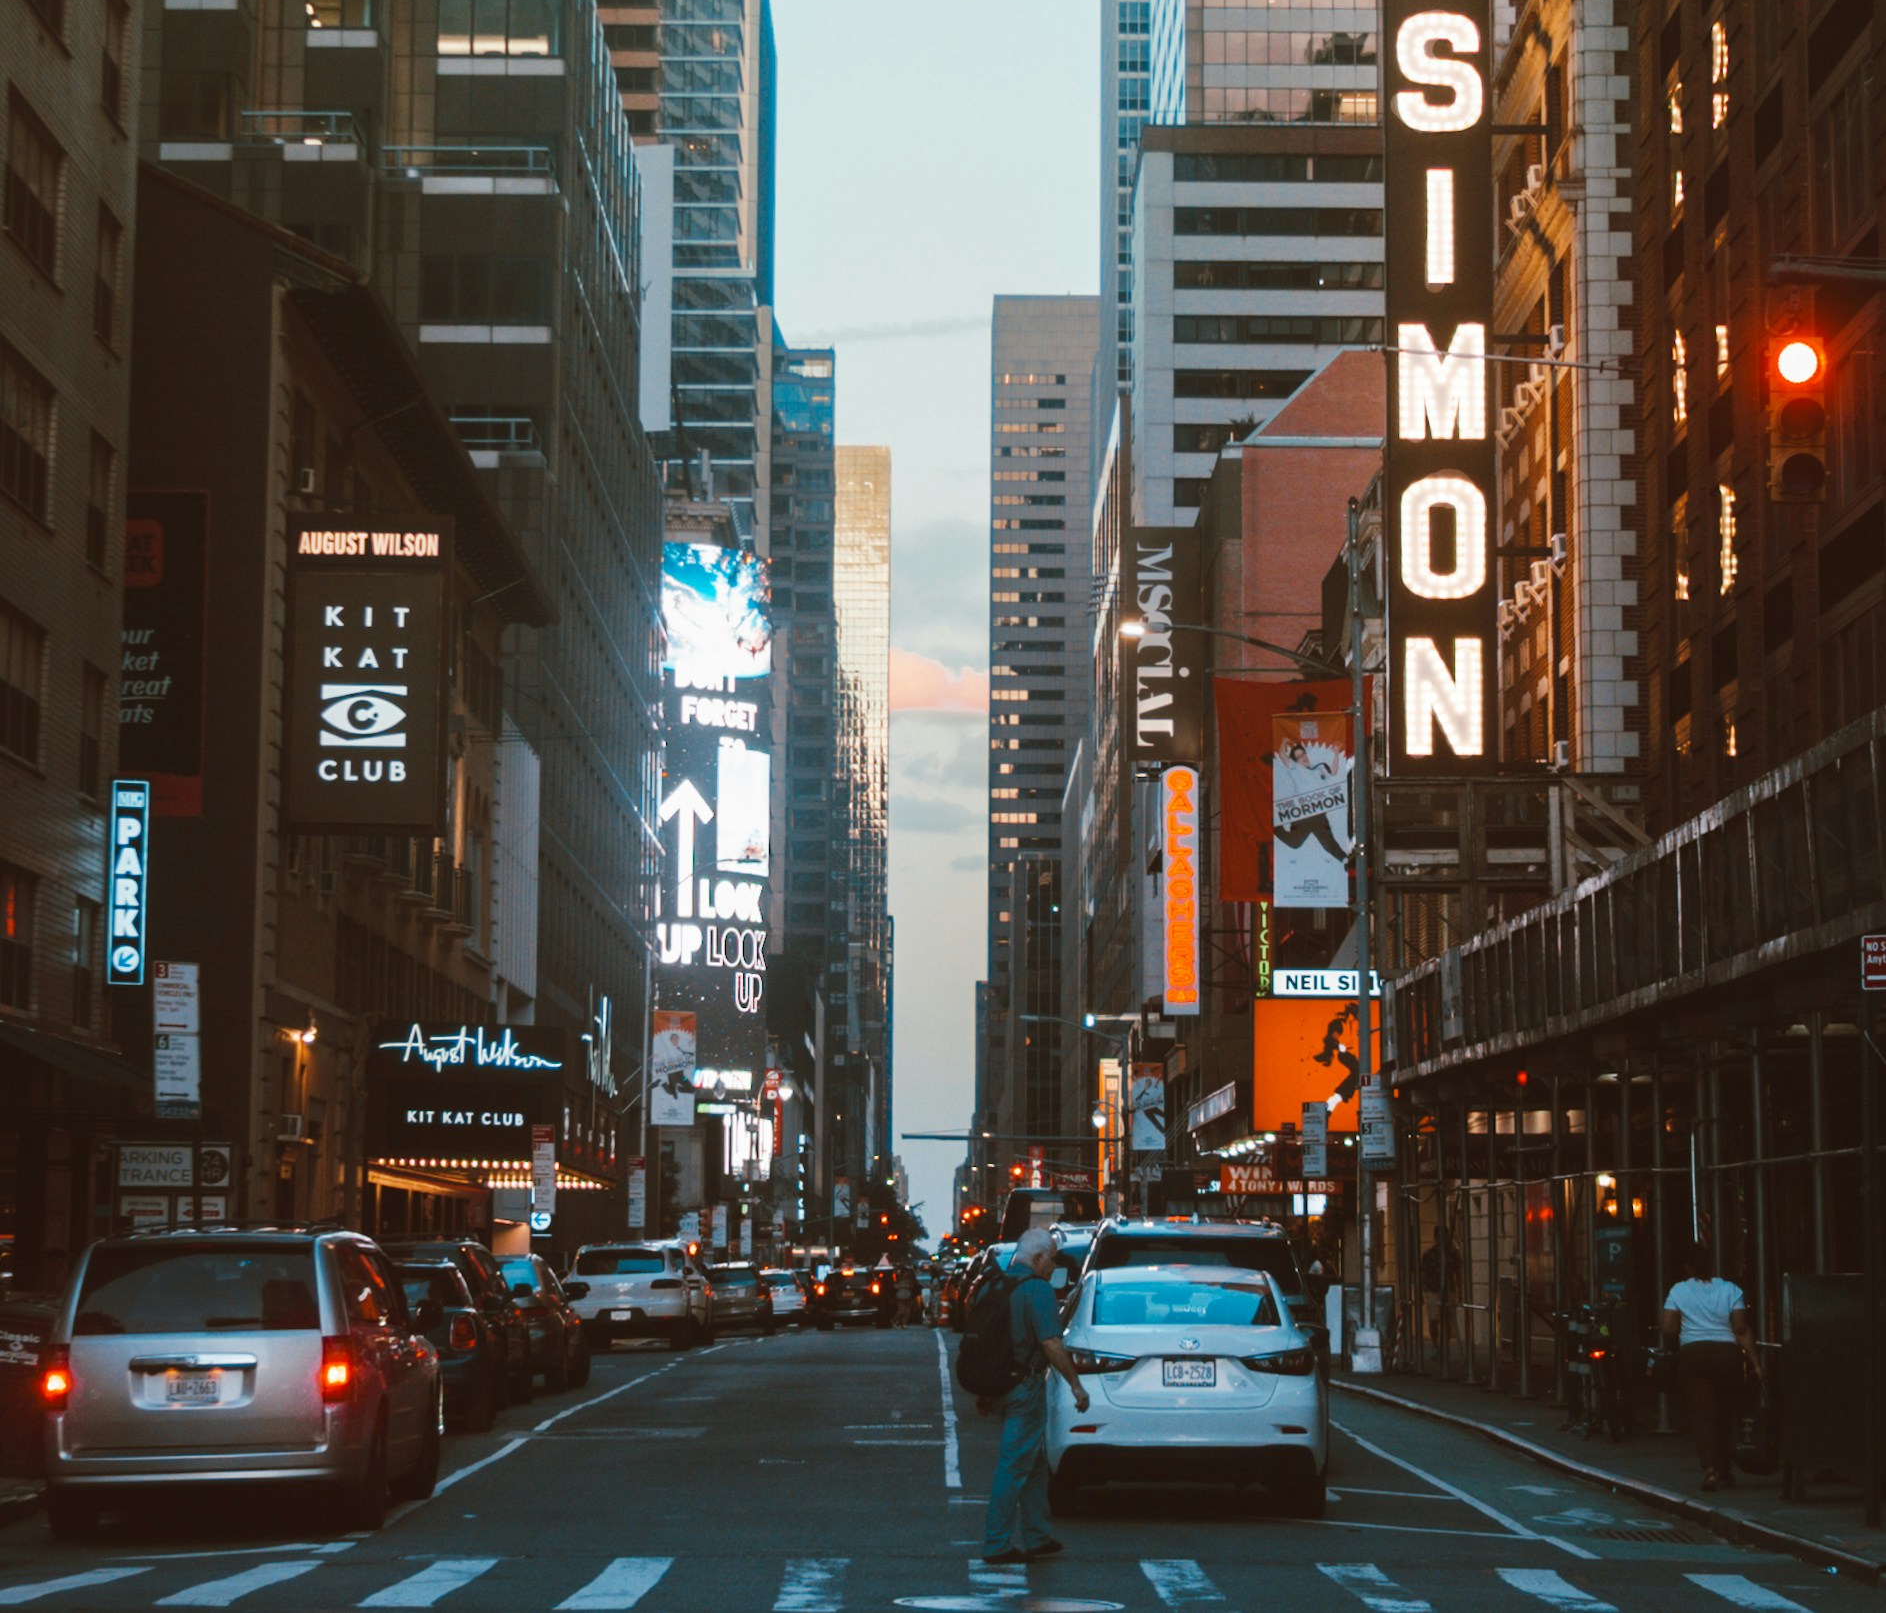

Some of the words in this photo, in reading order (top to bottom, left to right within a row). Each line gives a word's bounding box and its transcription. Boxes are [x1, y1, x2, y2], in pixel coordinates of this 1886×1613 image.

[1396, 11, 1487, 756] SIMON
[298, 531, 368, 555] AUGUST
[371, 533, 439, 557] WILSON
[324, 606, 410, 628] KIT
[323, 647, 409, 669] KAT
[681, 695, 758, 732] FORGET
[318, 760, 407, 783] CLUB
[1278, 793, 1346, 822] MORMON
[114, 817, 143, 937] PARK
[1166, 769, 1195, 987] GALLAGHERS
[699, 878, 763, 923] LOOK
[656, 923, 702, 964] UP
[706, 926, 767, 971] LOOK
[1866, 941, 1879, 952] NO
[158, 964, 166, 978] 3
[1286, 975, 1331, 990] NEIL
[735, 972, 763, 1013] UP
[158, 1035, 167, 1049] 6
[379, 1023, 477, 1073] August
[478, 1026, 562, 1069] Wilson
[406, 1110, 435, 1123] KIT
[442, 1111, 475, 1124] KAT
[480, 1112, 524, 1126] CLUB
[200, 1167, 222, 1179] HR
[203, 1155, 220, 1167] 24
[1239, 1180, 1276, 1192] TONY
